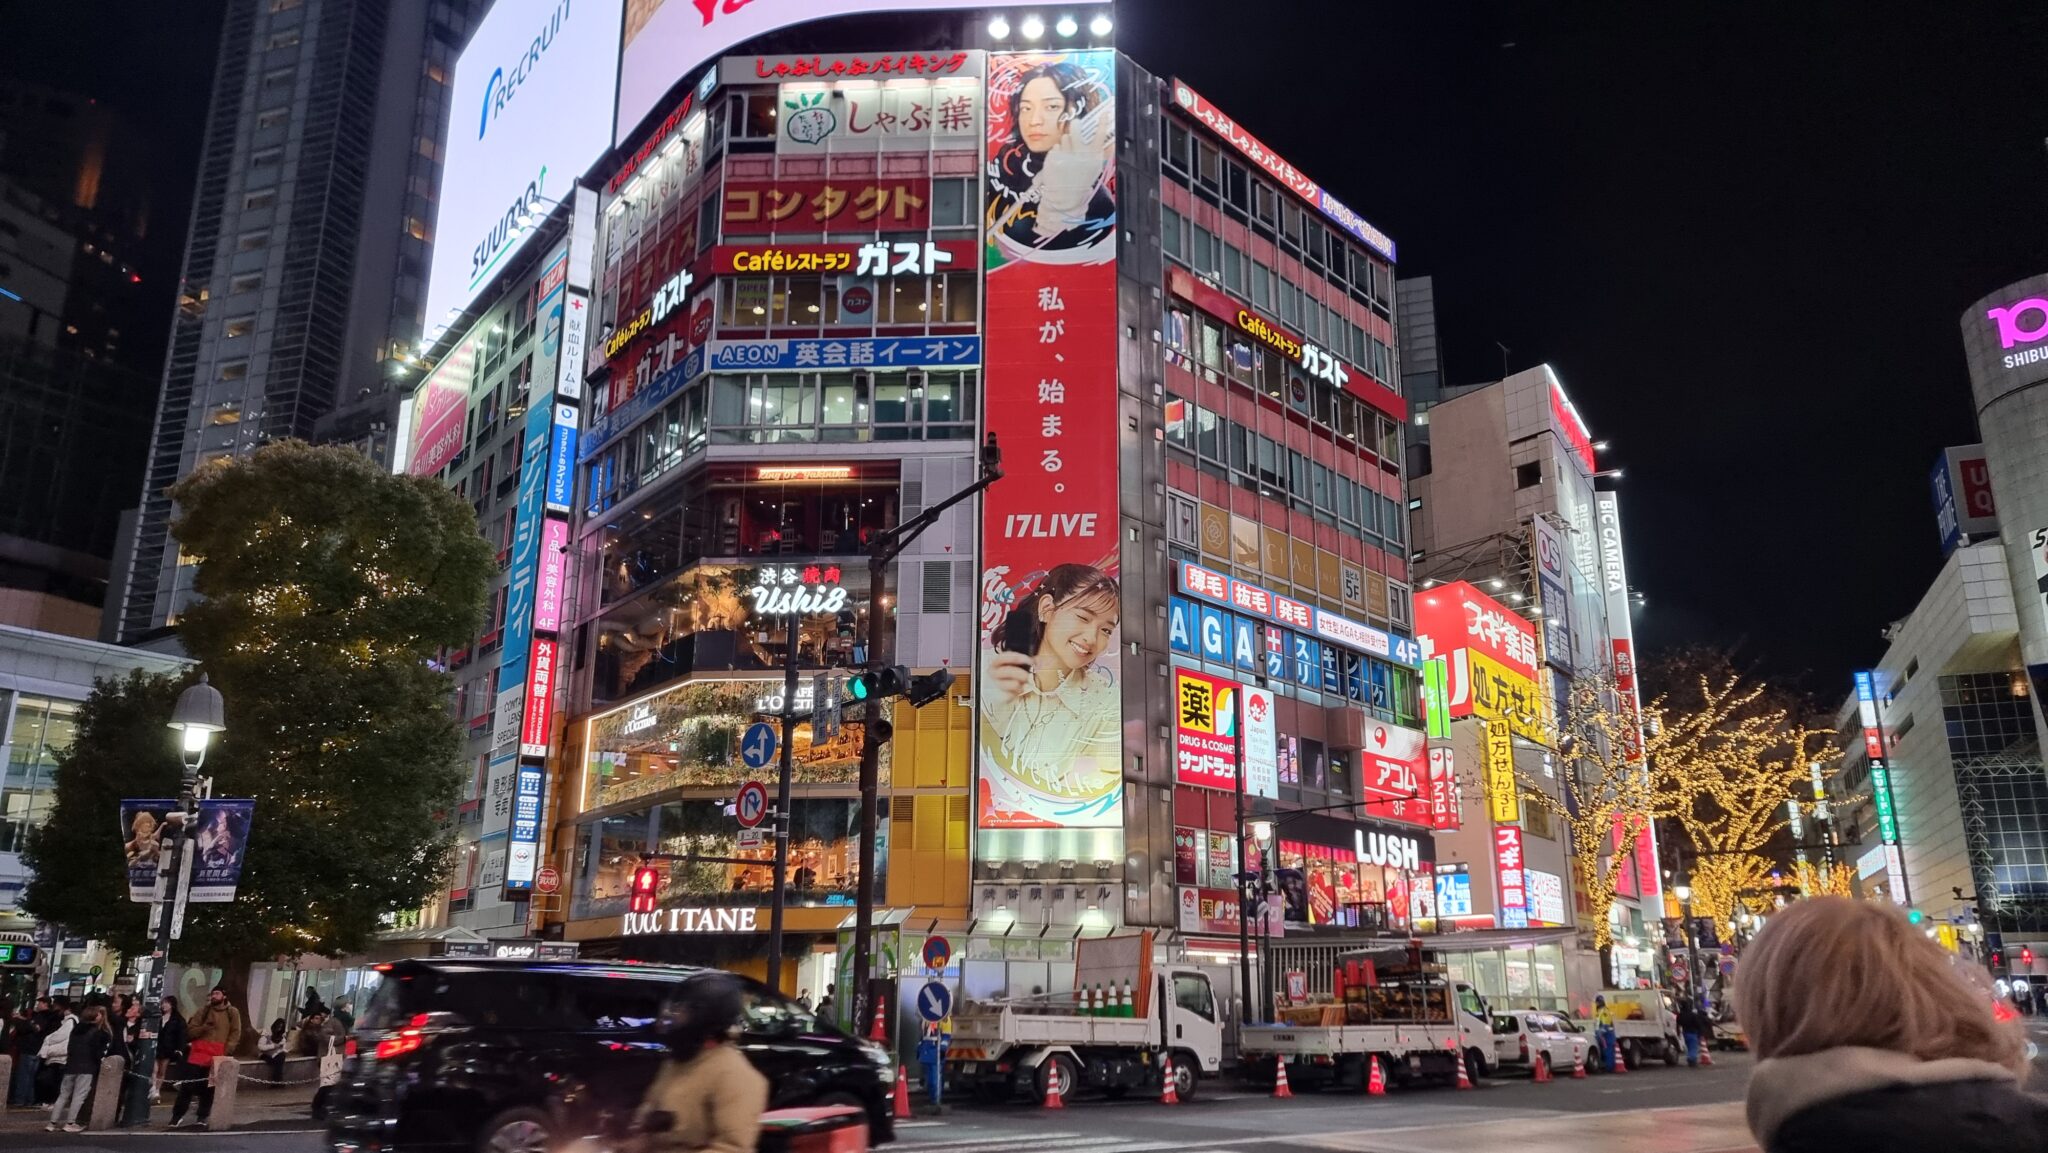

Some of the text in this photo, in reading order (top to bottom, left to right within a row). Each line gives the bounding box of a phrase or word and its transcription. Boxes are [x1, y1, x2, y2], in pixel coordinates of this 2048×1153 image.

[756, 52, 968, 77] しゃぶしゃぶバイキング
[849, 95, 973, 133] しゃぶ葉
[1192, 94, 1319, 199] しゃぶしゃぶバイキング
[725, 185, 927, 222] コンタクト
[856, 240, 952, 276] ガスト
[651, 268, 694, 327] ガスト
[564, 319, 581, 384] 献血ルーム
[720, 342, 975, 366] AEON 英会話イーオン
[1301, 342, 1349, 388] ガスト
[1037, 286, 1066, 493] 私が、始まる。
[1598, 500, 1622, 593] BIC CAMERA
[541, 537, 560, 614] 品川美容外科
[759, 566, 841, 585] 渋谷 焼肉
[1188, 567, 1225, 599] 薄毛
[1345, 579, 1360, 601] 5F
[752, 584, 848, 614] Ushi8
[1234, 581, 1268, 613] 抜毛
[538, 617, 555, 628] 4F
[1277, 600, 1310, 629] 発毛
[1169, 606, 1255, 664] AGA
[1462, 599, 1538, 672] スギ薬局
[1395, 639, 1418, 665] 4F
[533, 642, 552, 698] 外貨両替
[1182, 681, 1210, 728] 薬
[527, 745, 541, 755] 7F
[1180, 733, 1201, 747] DRUG
[1202, 739, 1208, 749] &
[1375, 759, 1418, 792] アコム
[1392, 800, 1406, 817] 3F
[1433, 781, 1446, 814] アコム
[1355, 829, 1420, 871] LUSH
[1497, 829, 1524, 906] スギ薬局
[1436, 875, 1456, 901] 24
[1203, 901, 1213, 919] 薬
